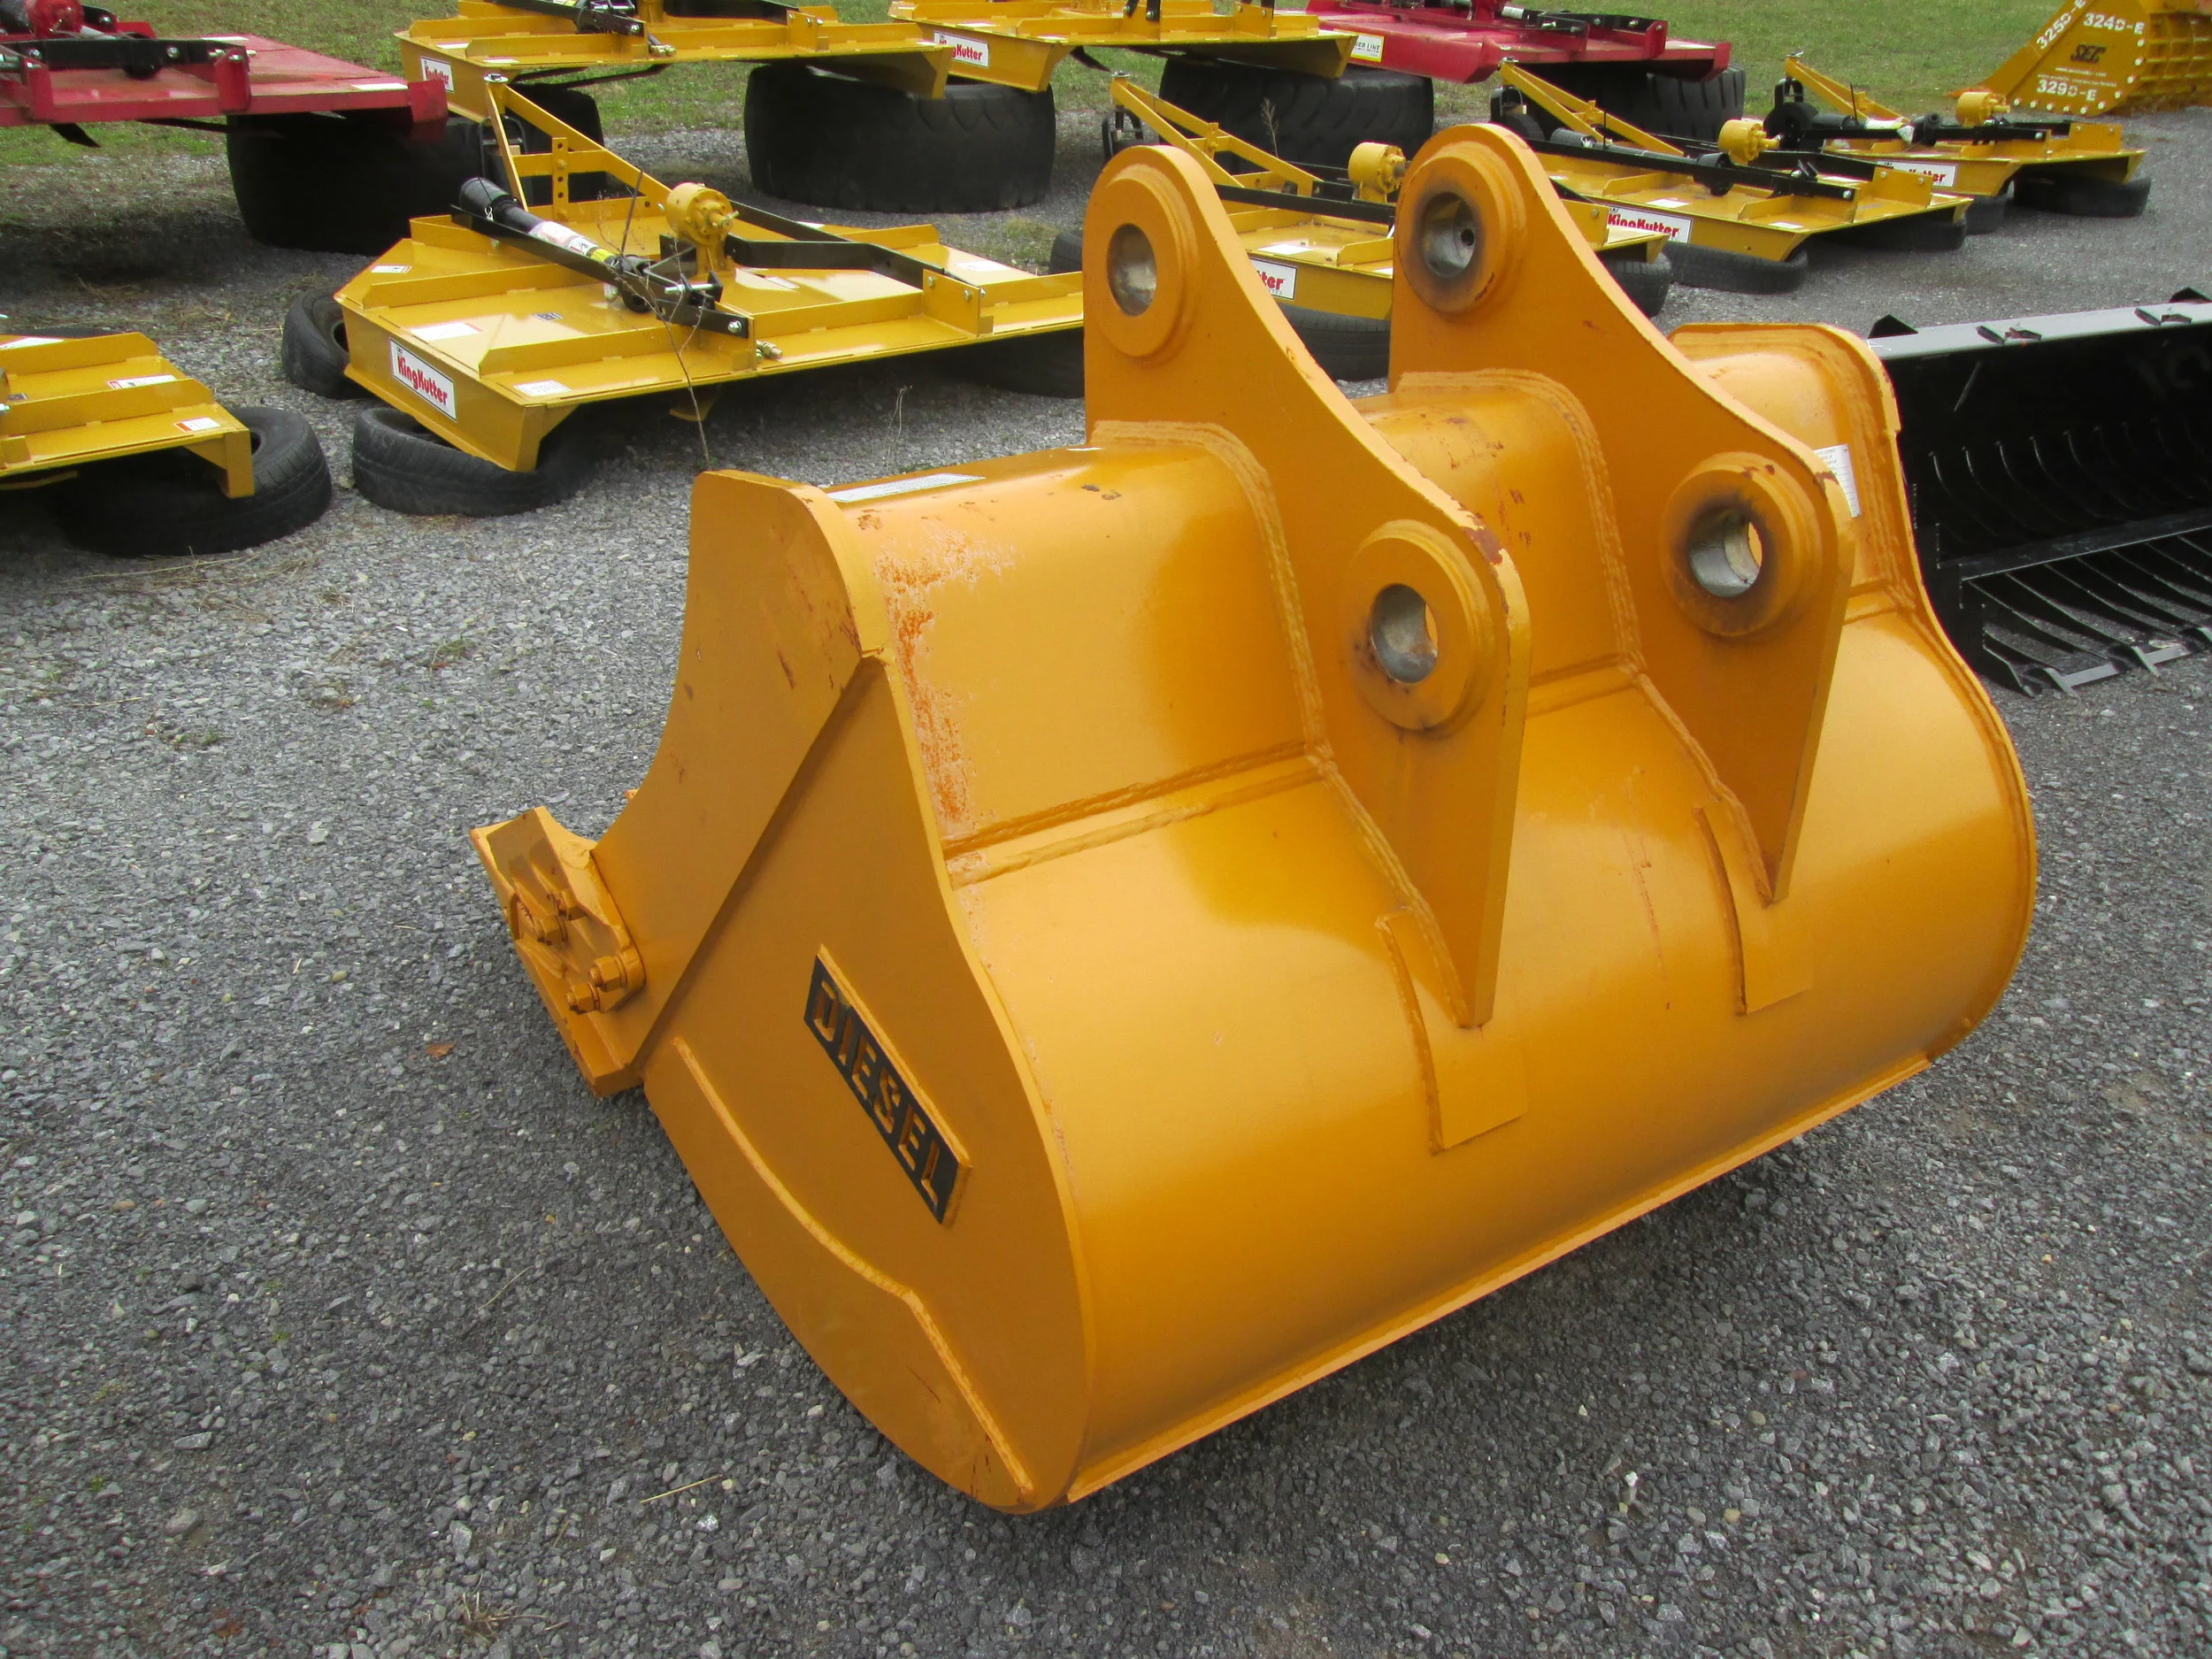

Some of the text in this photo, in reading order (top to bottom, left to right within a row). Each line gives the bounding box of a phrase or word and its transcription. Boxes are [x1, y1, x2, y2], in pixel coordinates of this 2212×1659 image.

[2084, 12, 2145, 35] 3240-E
[2037, 79, 2097, 102] 3290-E
[397, 355, 448, 405] KingKutter
[813, 979, 940, 1206] DIESEL
